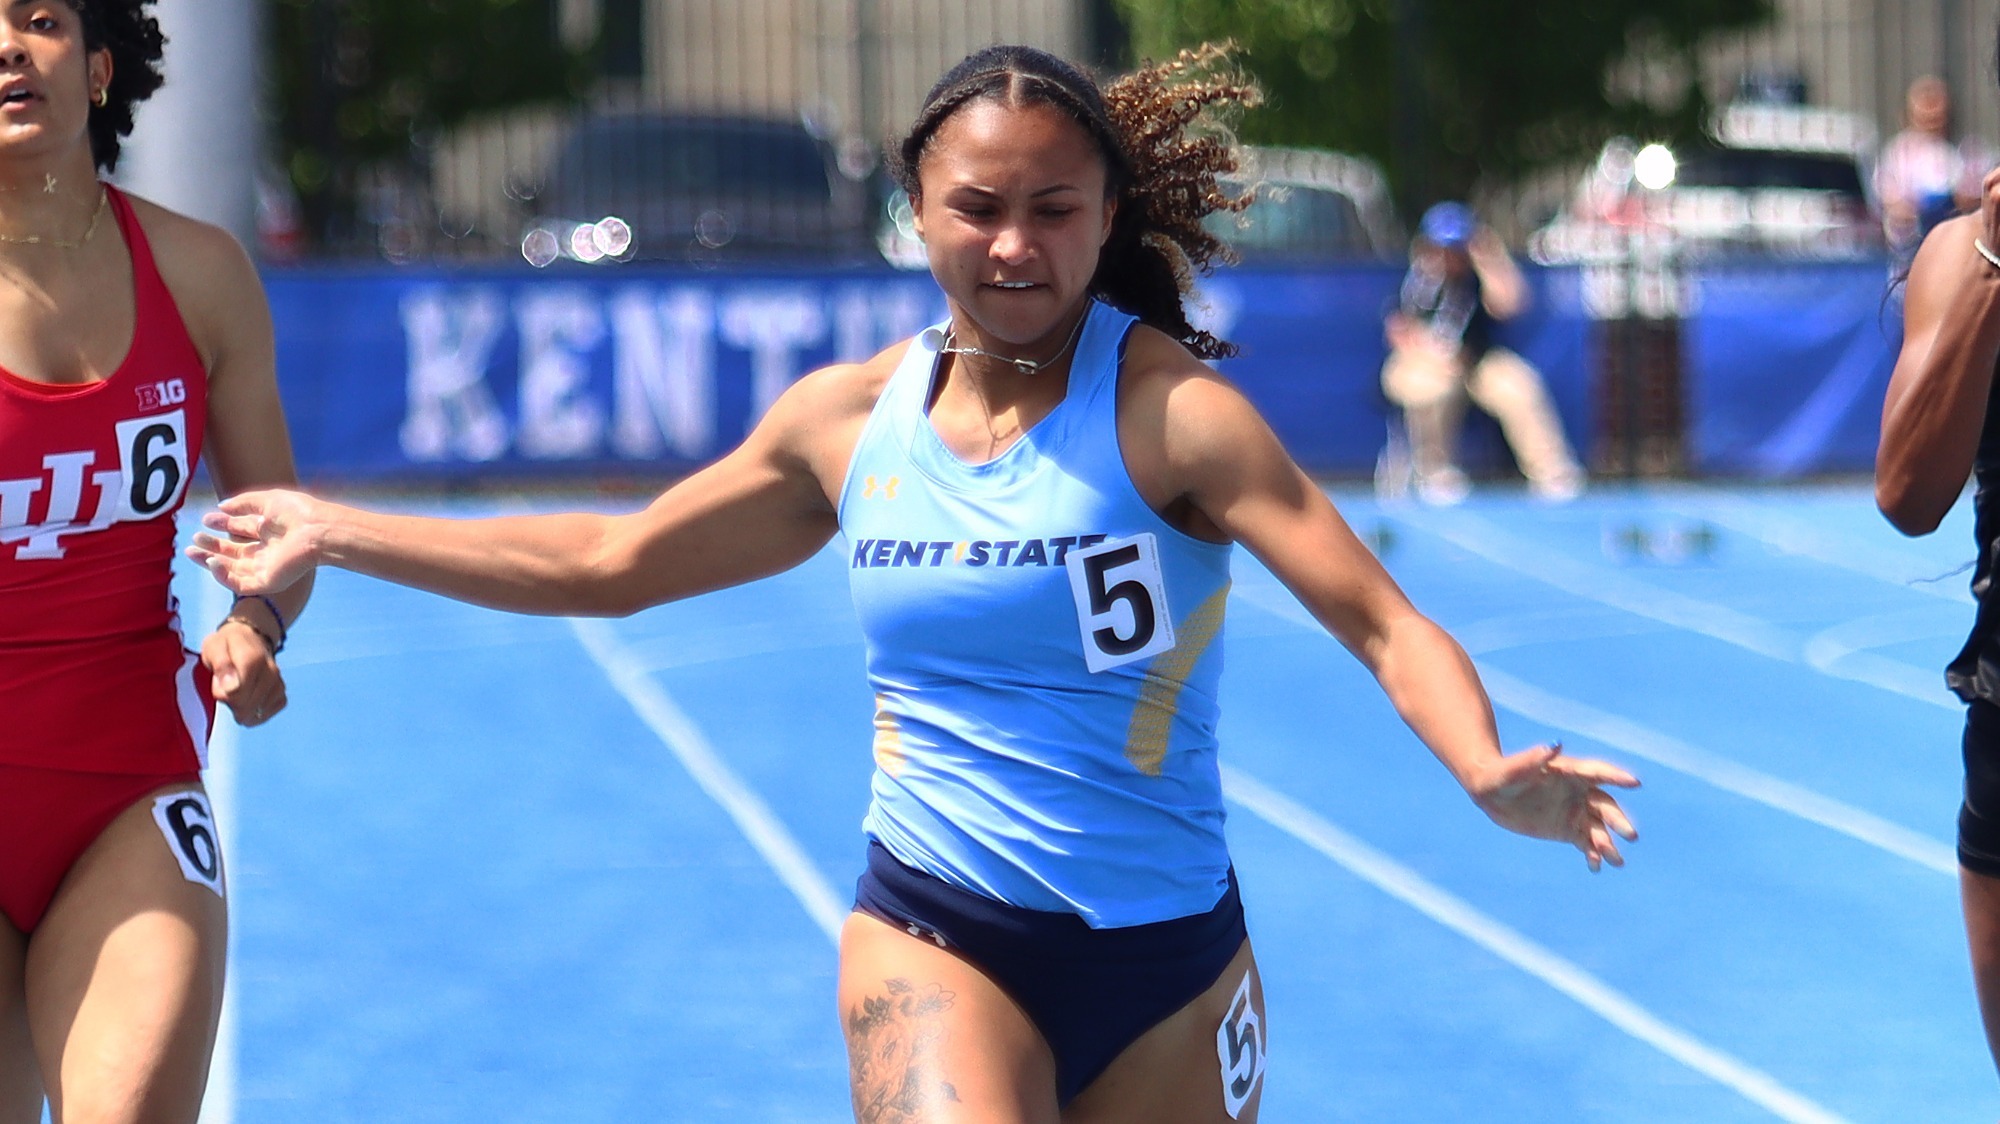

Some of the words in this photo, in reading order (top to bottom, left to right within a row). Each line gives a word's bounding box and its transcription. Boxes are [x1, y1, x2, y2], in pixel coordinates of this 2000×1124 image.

[131, 423, 180, 515] 6
[852, 538, 955, 569] KENT
[1083, 543, 1155, 656] 5
[166, 798, 217, 882] 6
[1225, 989, 1257, 1100] 5
